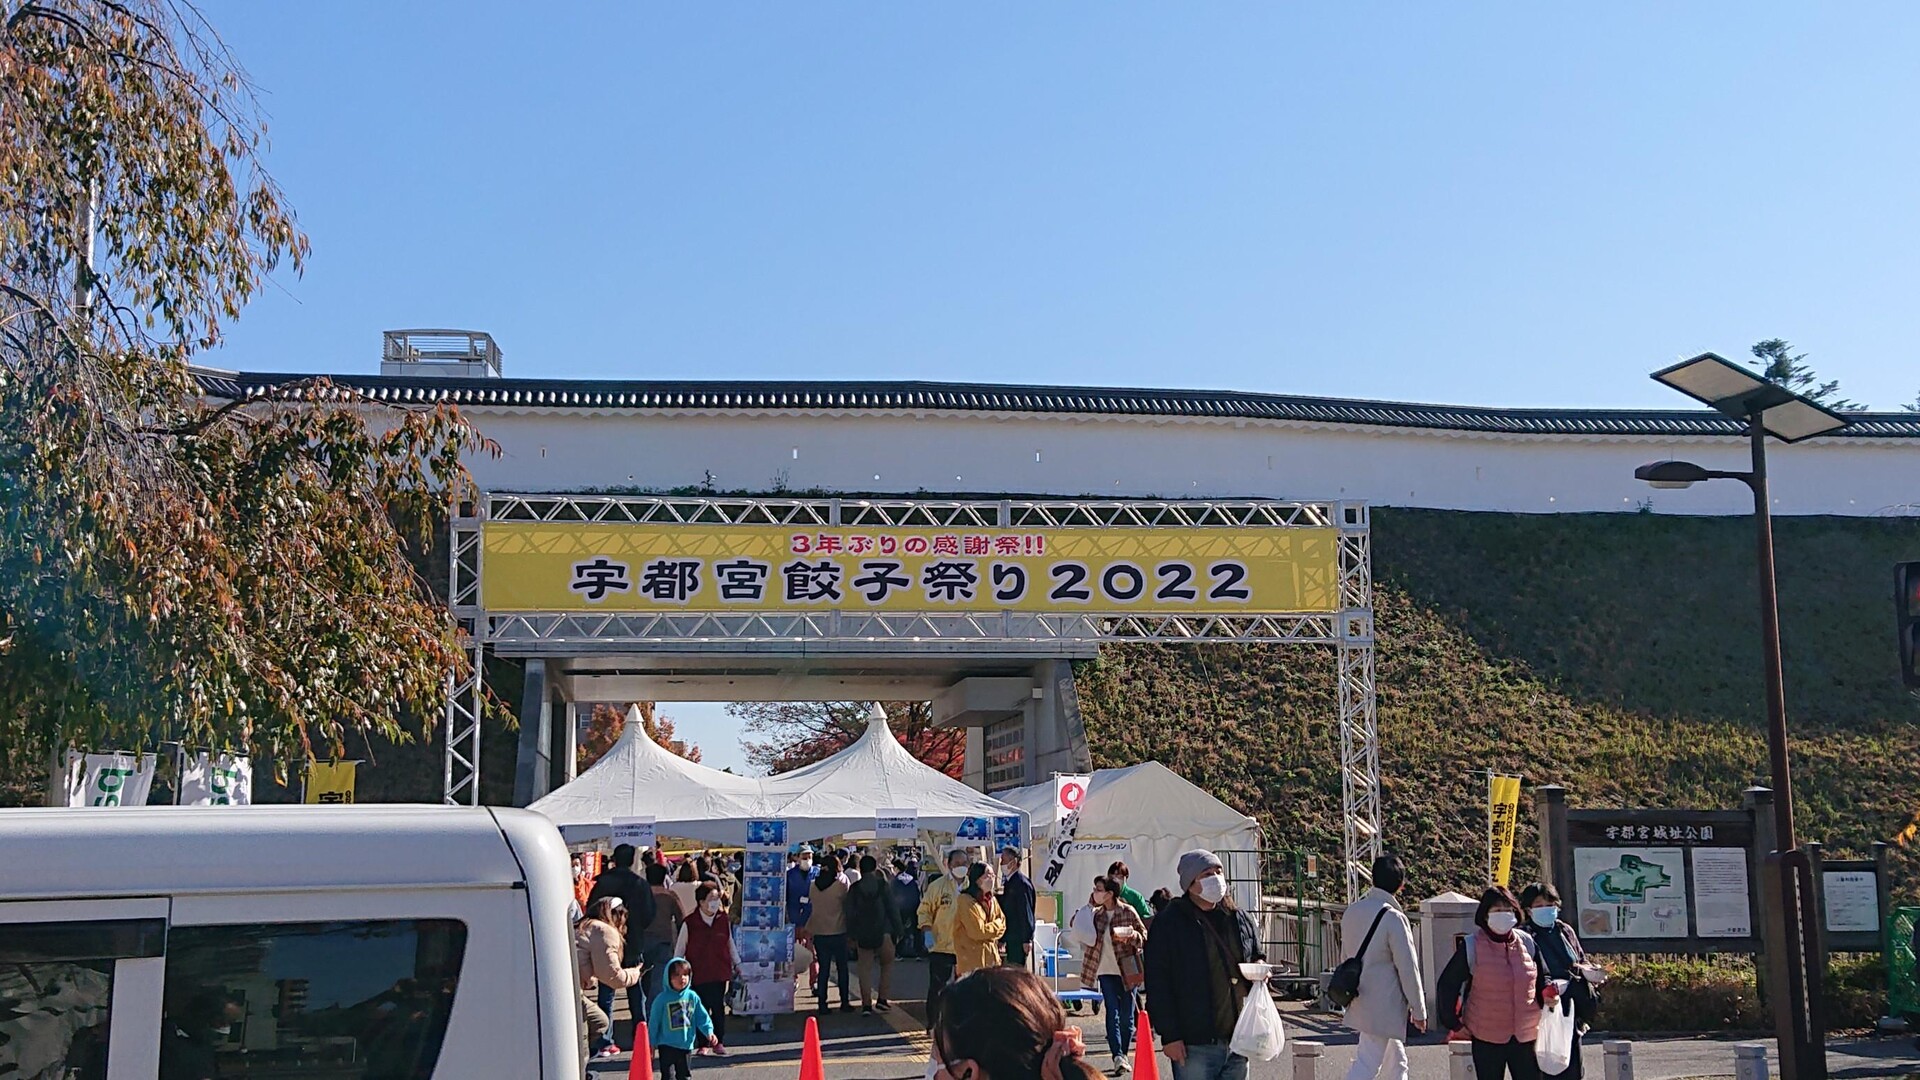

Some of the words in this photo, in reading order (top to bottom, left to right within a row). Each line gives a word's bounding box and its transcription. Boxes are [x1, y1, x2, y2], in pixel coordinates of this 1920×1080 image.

[791, 534, 1044, 555] 3年ぶりの感謝祭!!
[572, 560, 1249, 600] 宇都宮餃子祭り2022
[1605, 825, 1713, 840] 宇都宮城址公園
[1074, 842, 1127, 850] インフォメーション
